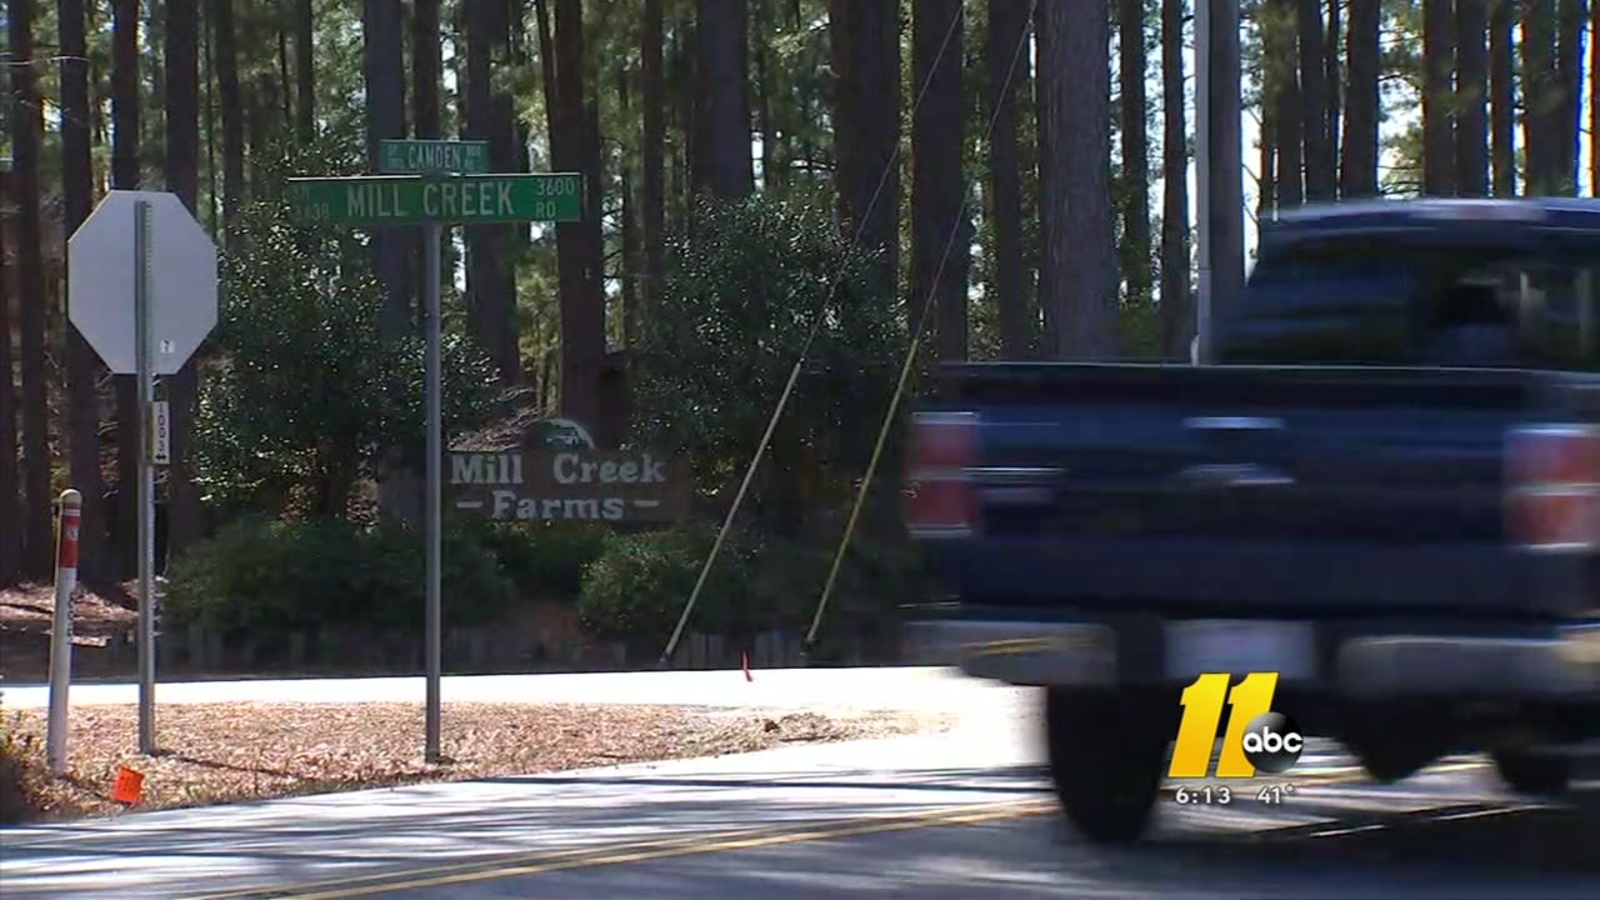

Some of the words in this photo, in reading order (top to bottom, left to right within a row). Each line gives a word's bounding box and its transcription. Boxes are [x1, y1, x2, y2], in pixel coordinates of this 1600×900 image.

[408, 145, 461, 169] CAMDEN
[347, 183, 407, 218] MILL
[423, 181, 515, 216] CREEK
[535, 177, 576, 196] 3600
[535, 201, 557, 219] RD
[450, 454, 524, 484] Mill
[553, 453, 667, 484] Creek
[491, 489, 625, 519] Farms
